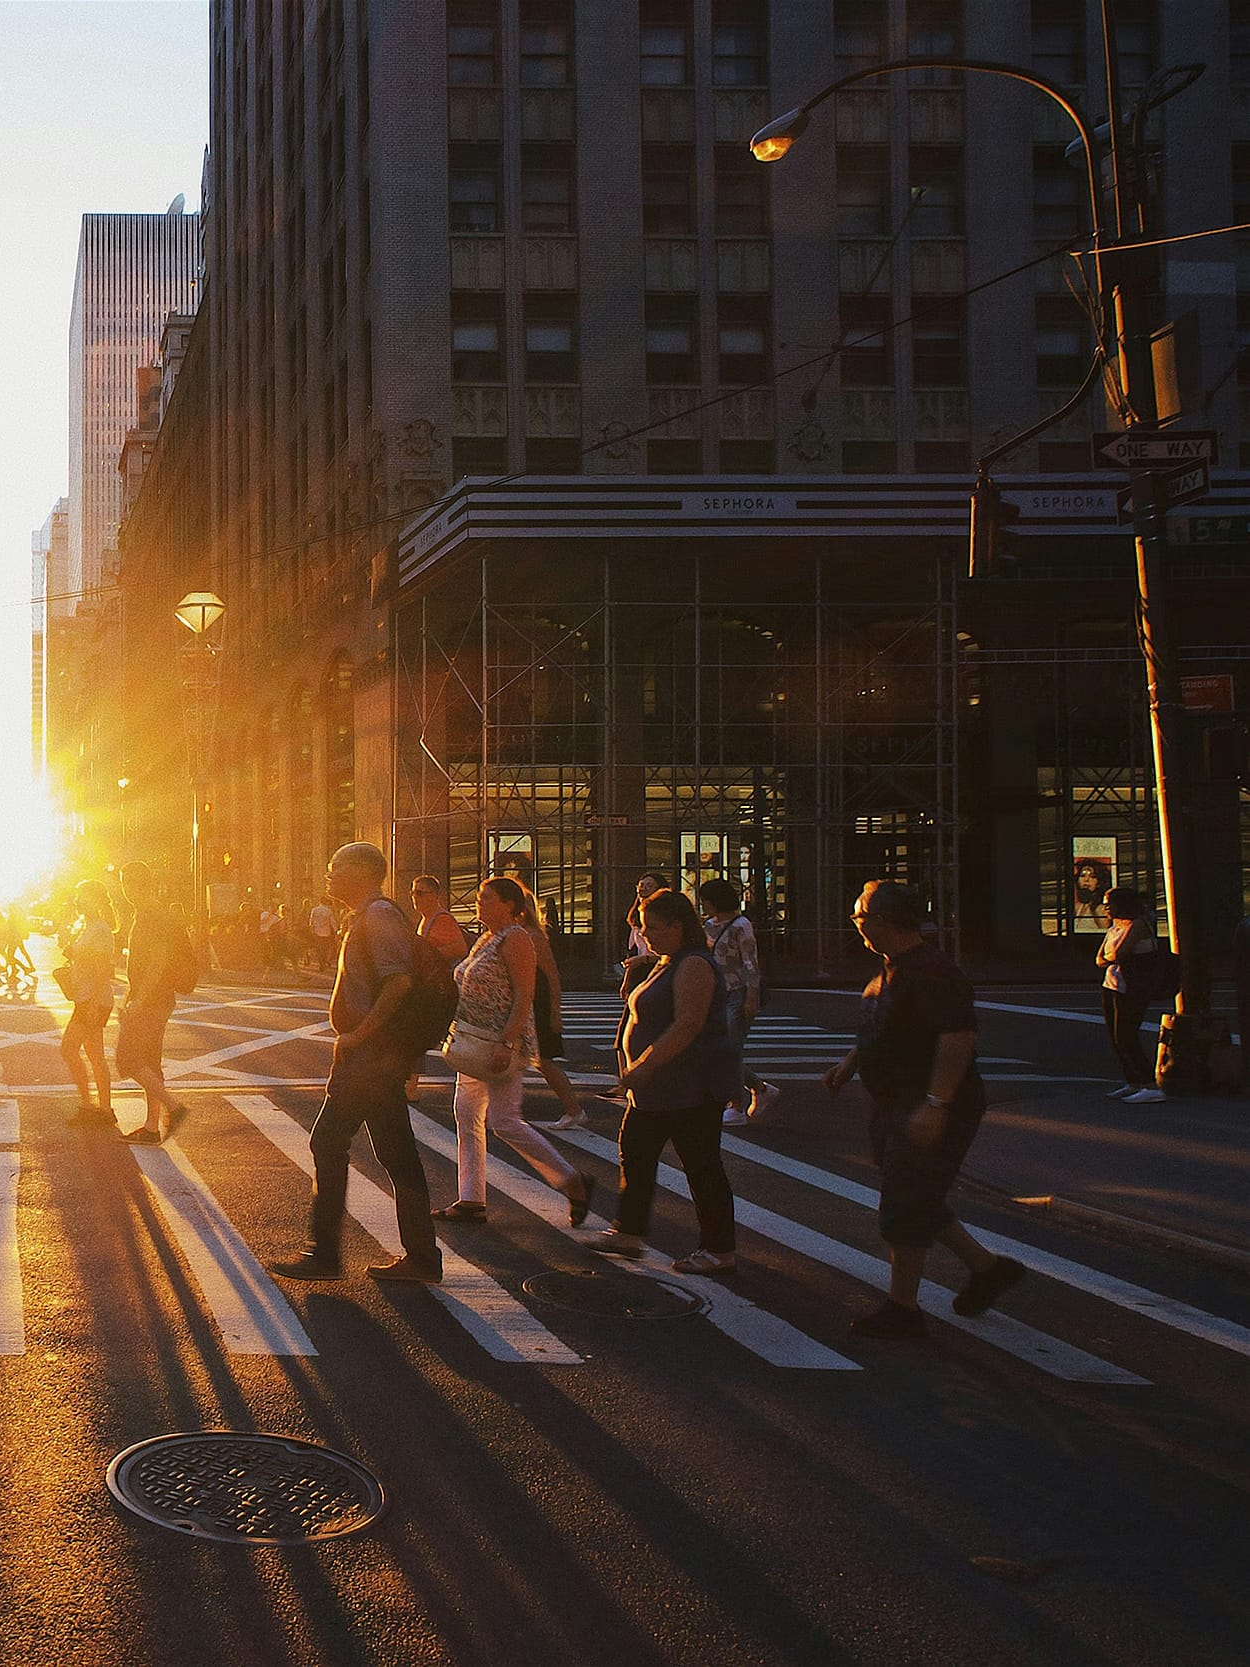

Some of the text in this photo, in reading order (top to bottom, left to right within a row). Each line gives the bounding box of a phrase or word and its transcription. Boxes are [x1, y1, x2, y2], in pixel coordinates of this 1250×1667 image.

[1117, 441, 1203, 457] ONE WAY
[703, 498, 775, 509] SEPHORA
[1033, 496, 1104, 508] SEPHORA
[1179, 679, 1219, 688] TANDING
